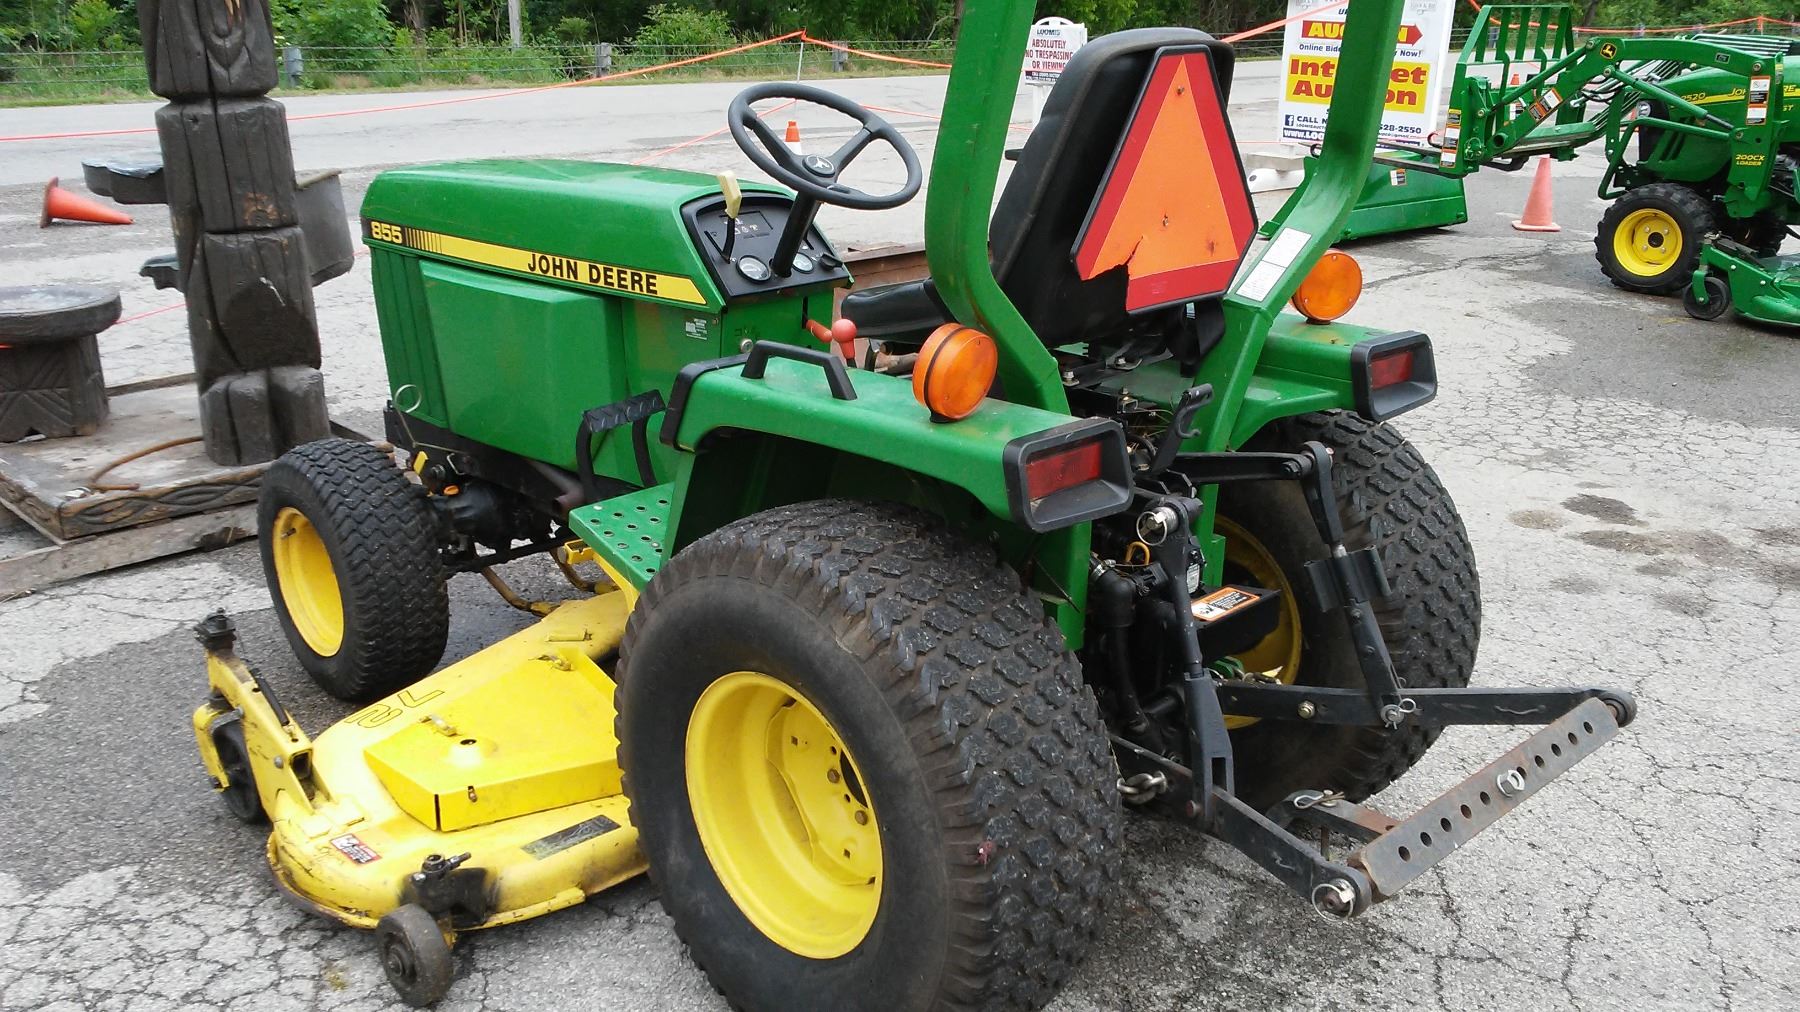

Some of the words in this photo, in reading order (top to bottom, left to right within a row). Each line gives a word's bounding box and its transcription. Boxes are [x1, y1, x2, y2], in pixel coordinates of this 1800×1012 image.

[1031, 38, 1067, 49] ABSOLUTELY
[1025, 49, 1034, 58] NO
[1031, 60, 1041, 69] OR
[1296, 115, 1319, 124] CALL
[370, 221, 403, 244] 855
[528, 253, 579, 281] JOHN
[588, 264, 658, 296] DEERE
